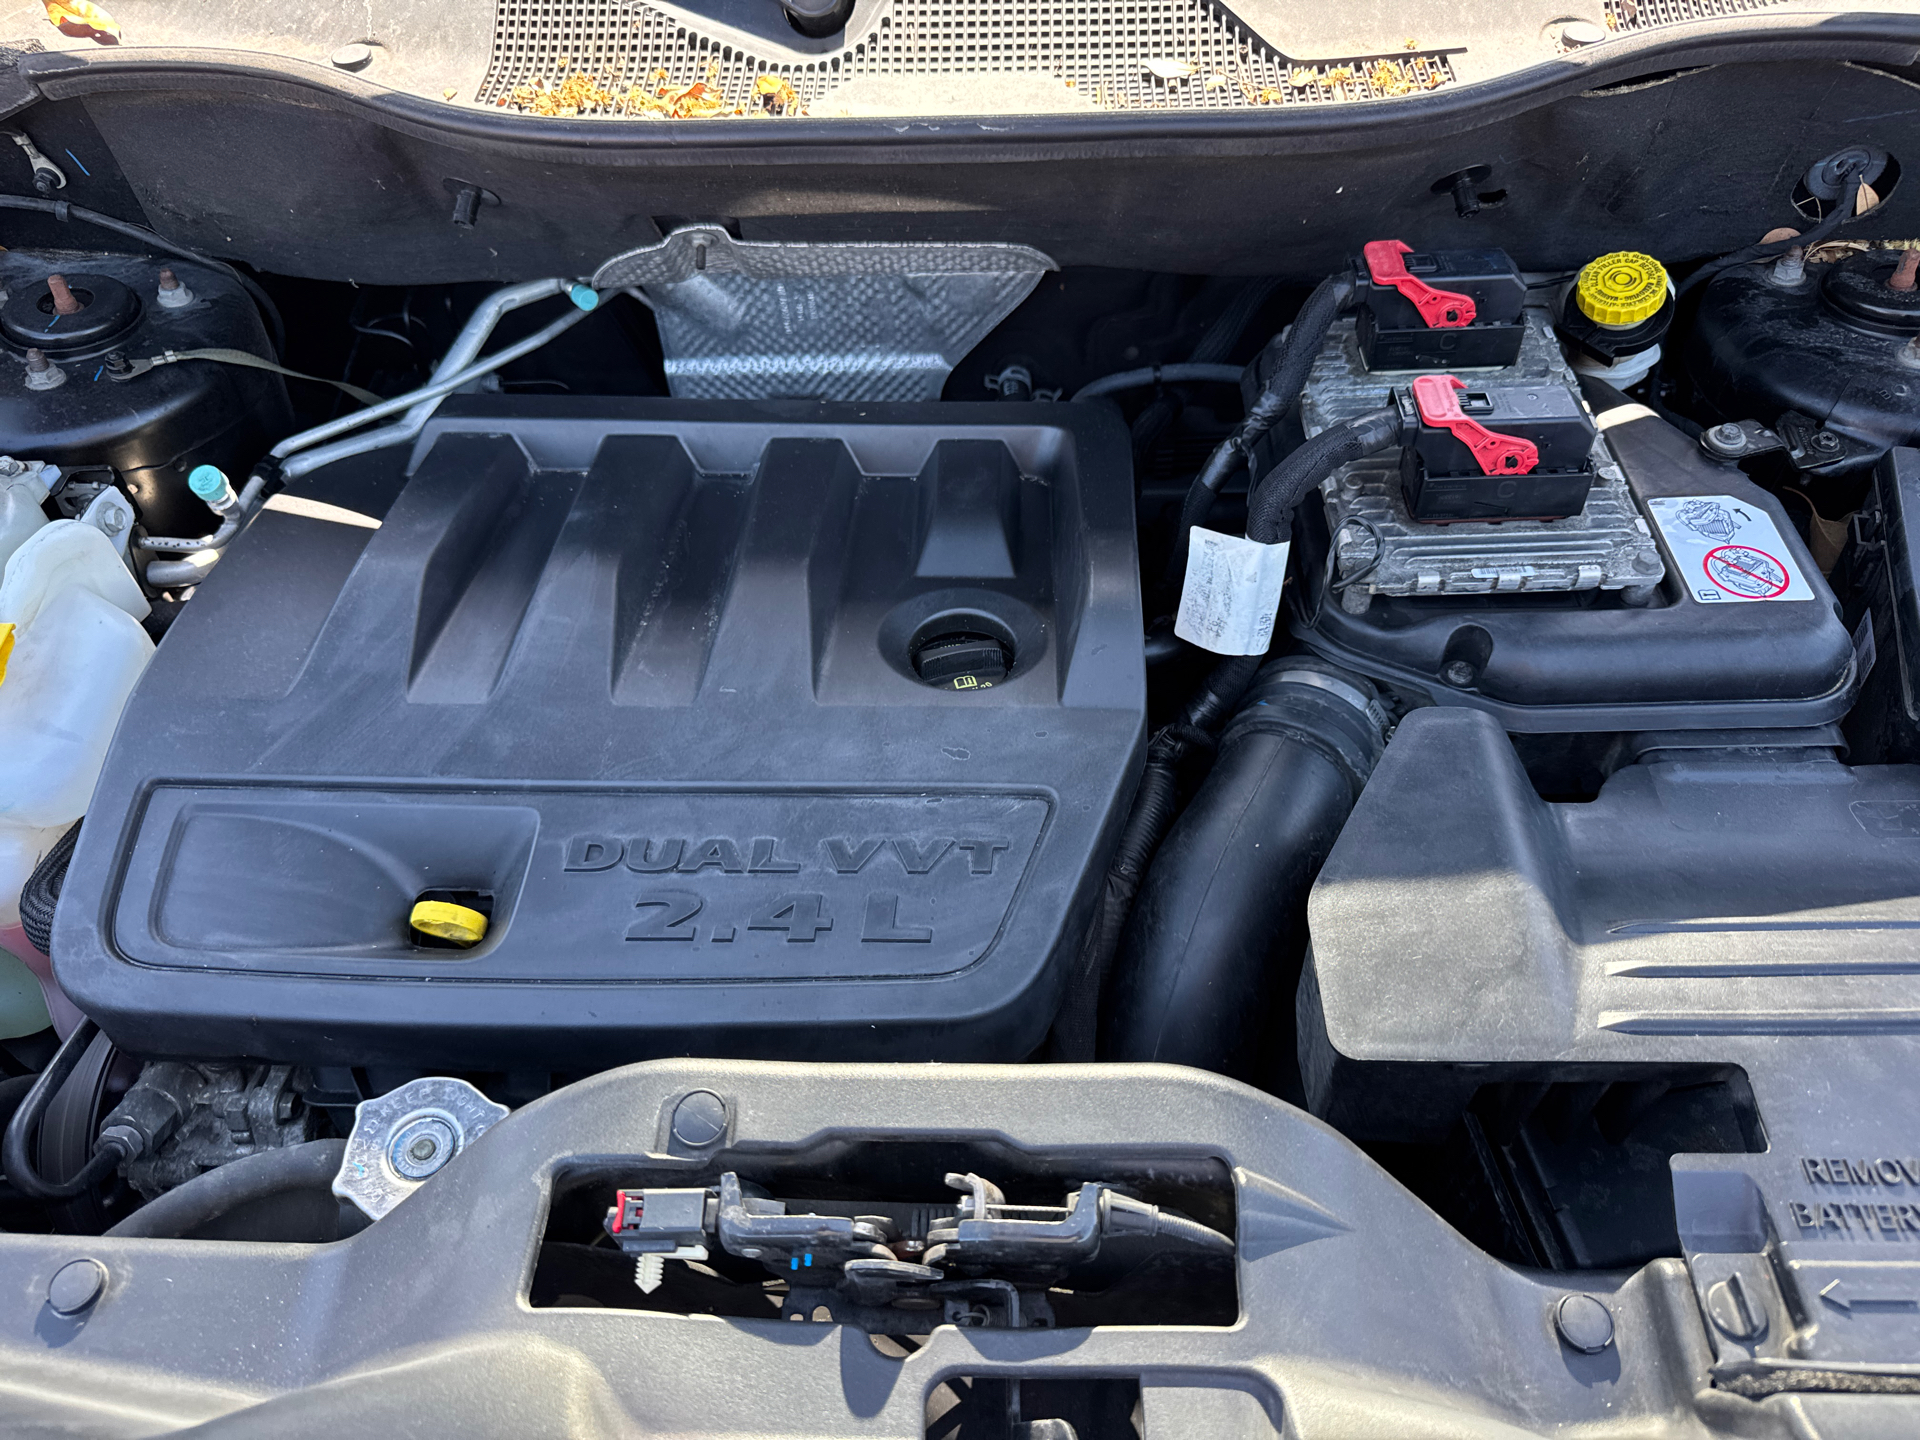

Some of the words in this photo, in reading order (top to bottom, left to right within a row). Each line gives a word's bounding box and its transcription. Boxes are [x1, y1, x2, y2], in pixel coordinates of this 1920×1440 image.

[1597, 258, 1621, 271] FILLER
[1639, 262, 1656, 280] BEFORE
[1439, 332, 1458, 350] C
[1496, 480, 1518, 499] C
[563, 835, 801, 875] DUAL
[822, 835, 1010, 876] VVT
[624, 890, 834, 944] 2.4
[860, 891, 933, 944] L
[380, 1086, 435, 1117] KEEP
